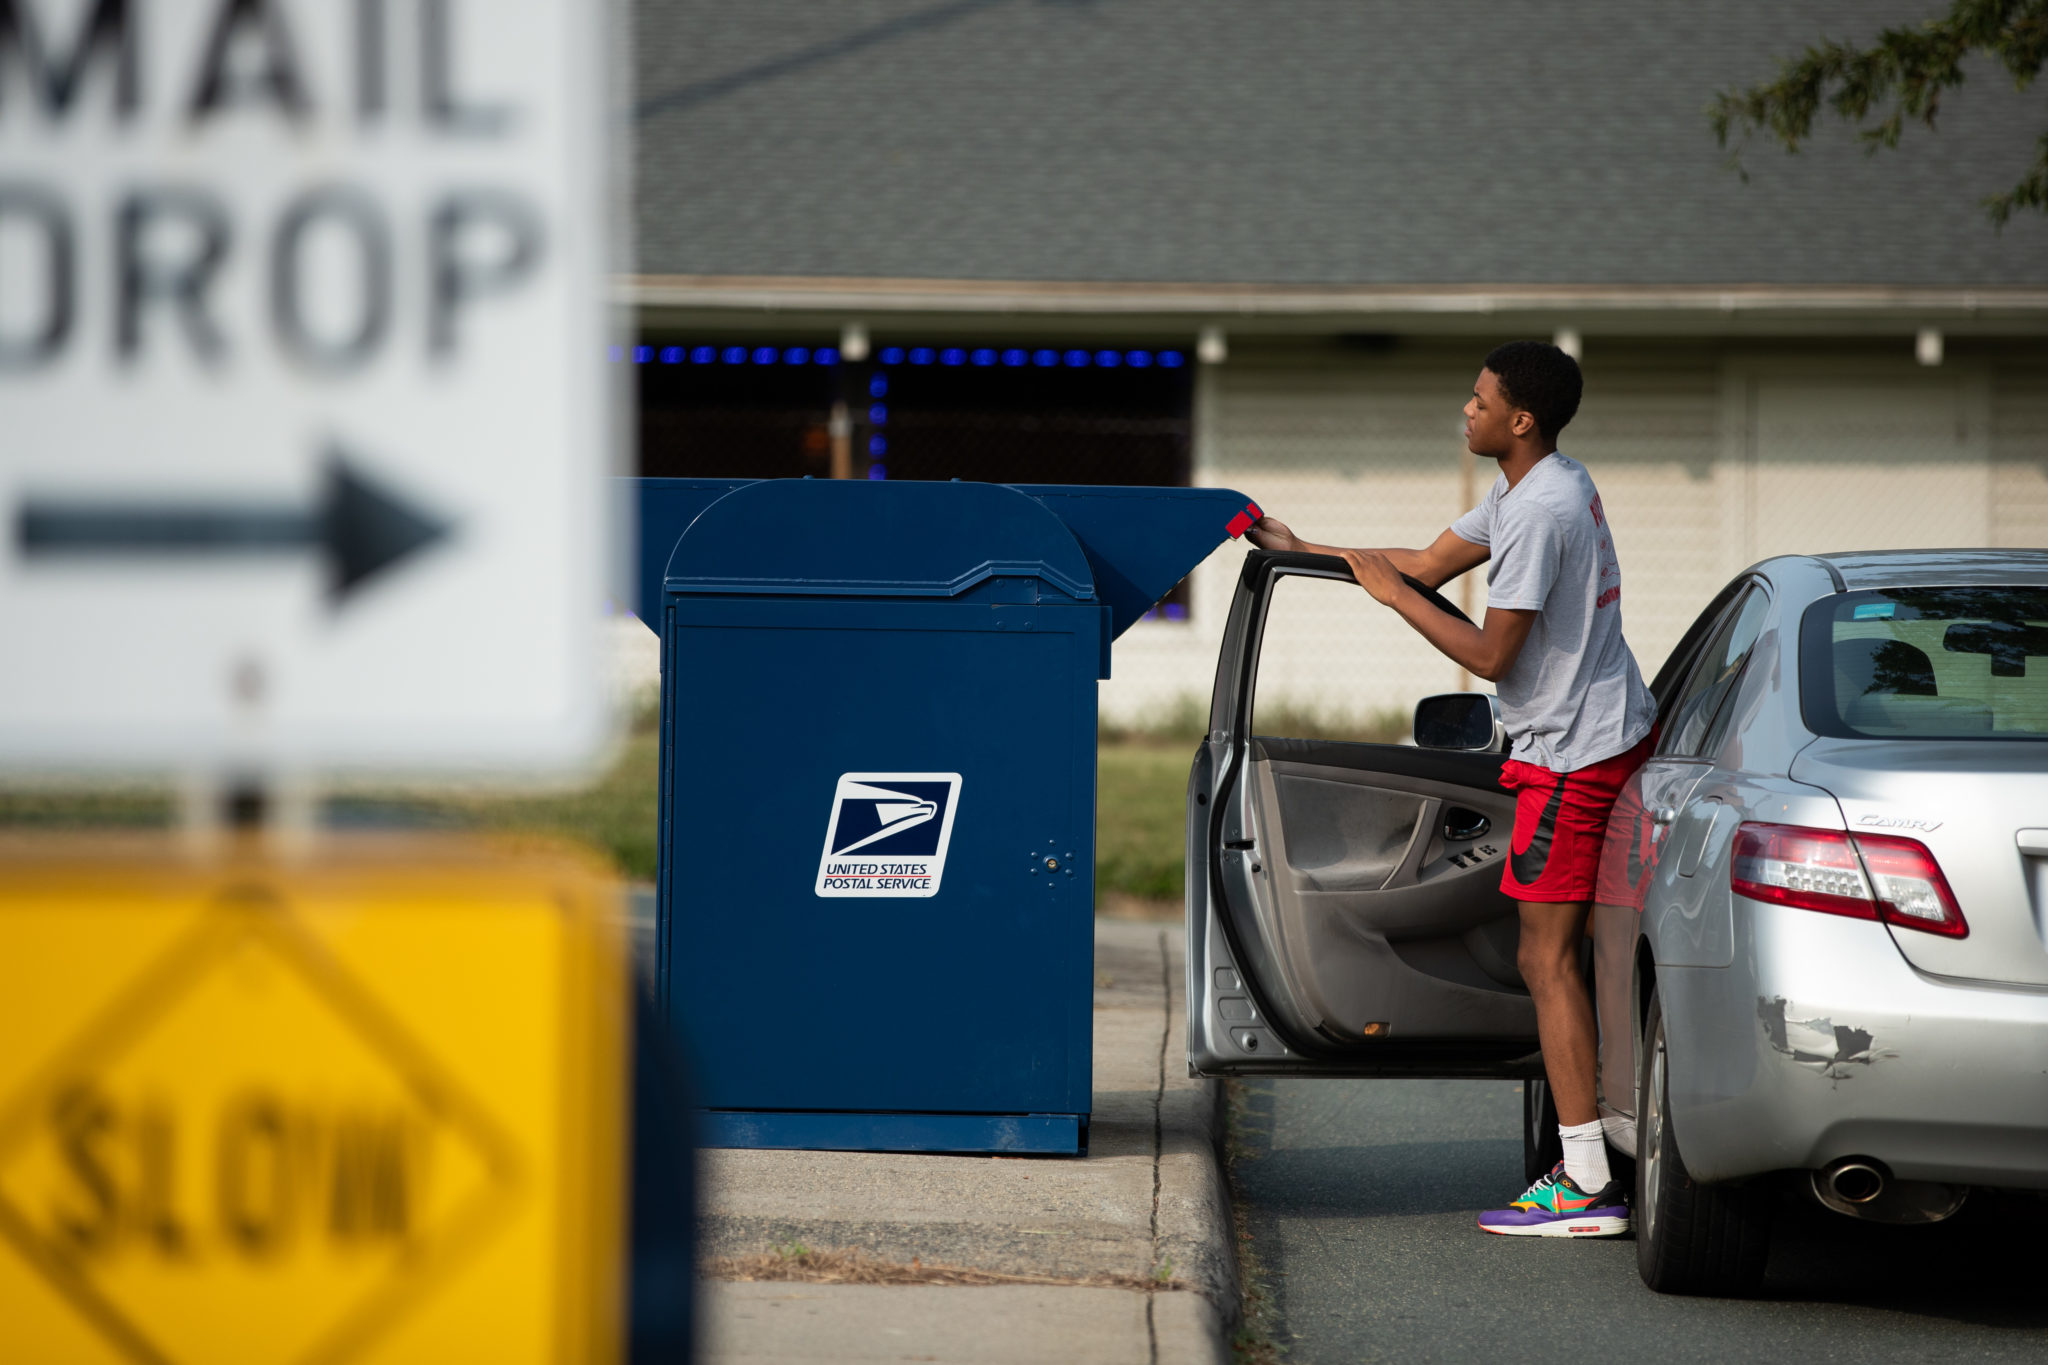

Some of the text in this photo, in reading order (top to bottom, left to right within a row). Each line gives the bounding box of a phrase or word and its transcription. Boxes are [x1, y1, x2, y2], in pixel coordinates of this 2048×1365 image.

[826, 864, 927, 875] UNITED STATES
[823, 878, 931, 889] POSTAL SERVICE
[48, 1080, 424, 1268] SLOW
